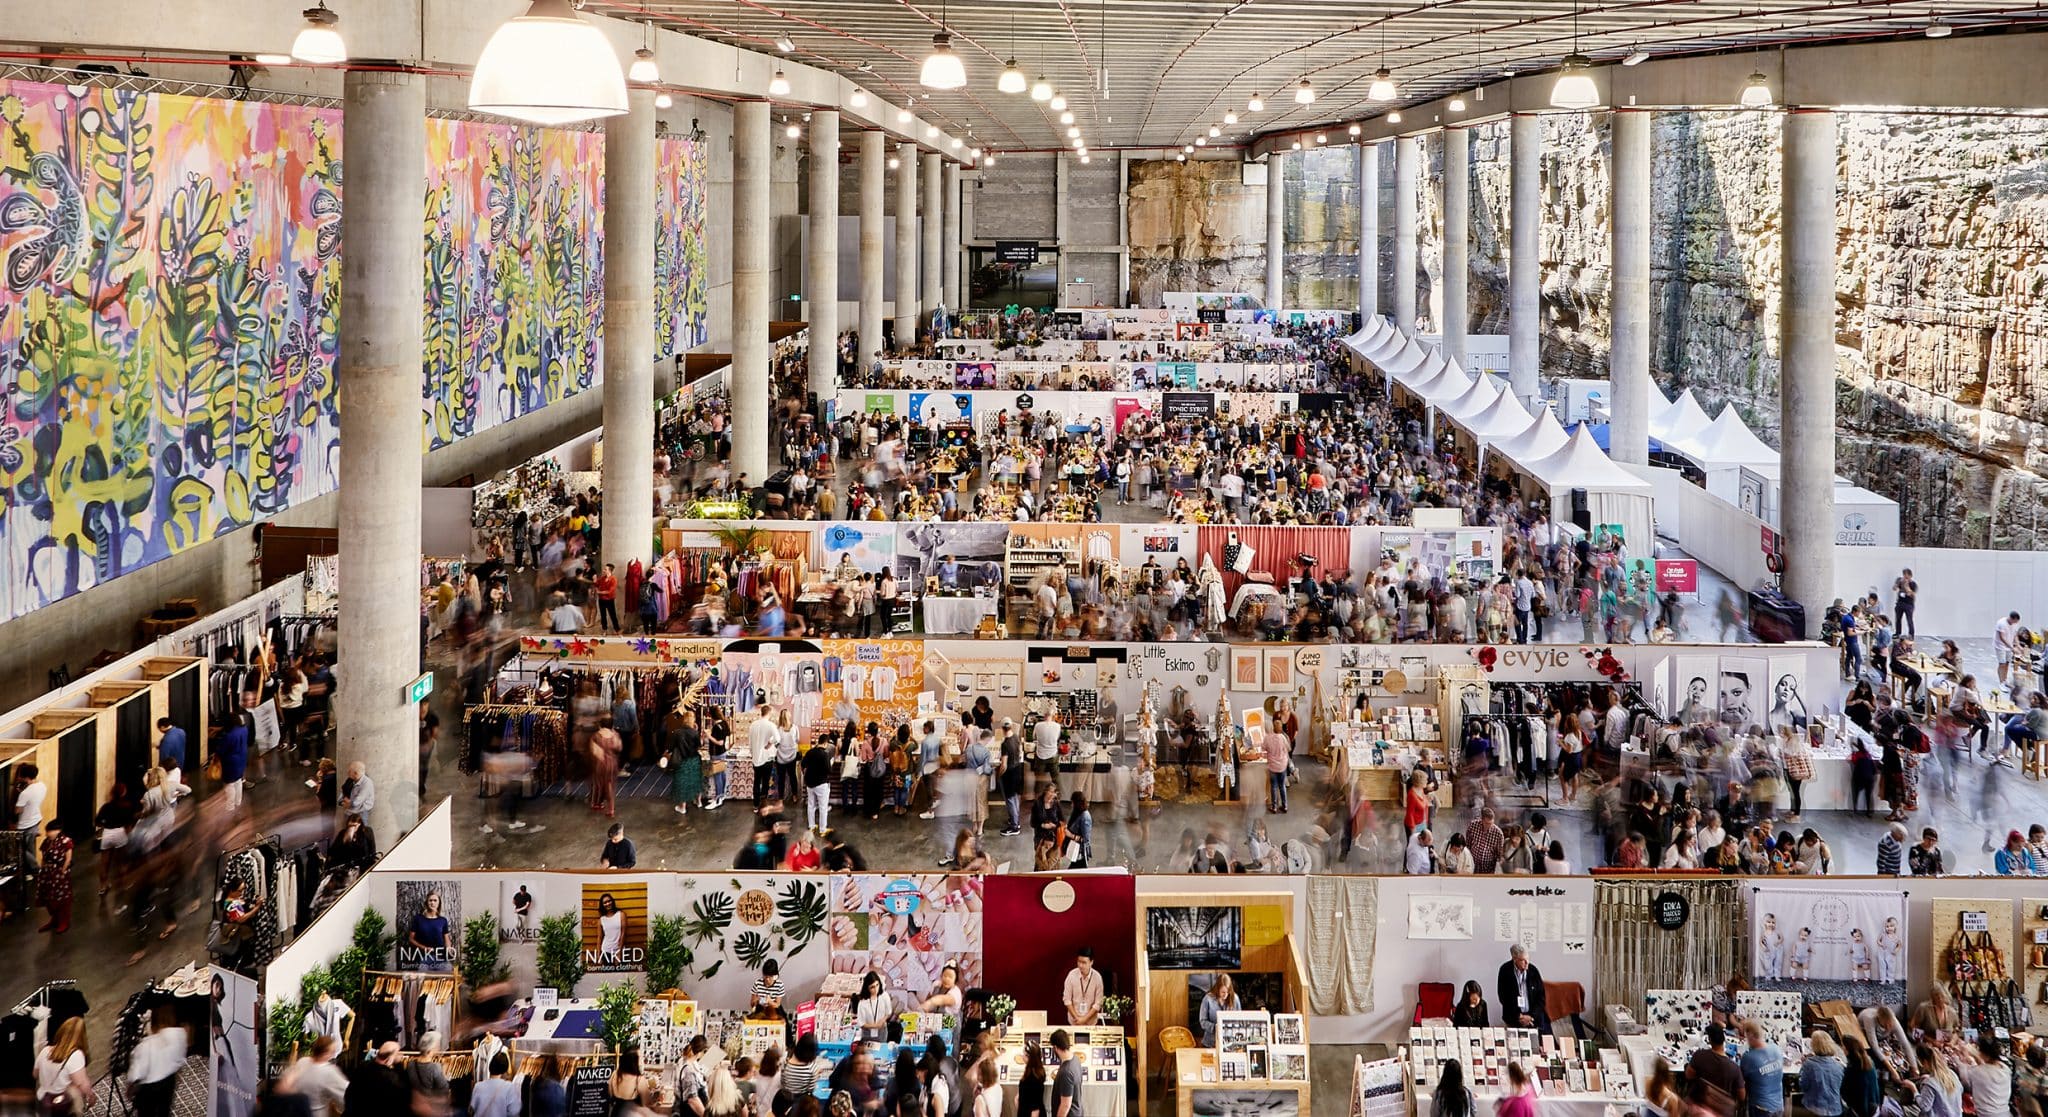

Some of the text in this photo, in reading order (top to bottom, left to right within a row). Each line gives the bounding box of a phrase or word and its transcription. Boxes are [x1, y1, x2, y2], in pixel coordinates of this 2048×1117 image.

[1836, 531, 1875, 542] CHILL
[1143, 646, 1166, 658] Little
[1165, 659, 1195, 671] Eskimo
[1503, 648, 1570, 673] evyie
[501, 927, 541, 938] NAKED
[400, 946, 457, 961] NAKED
[585, 947, 644, 963] NAKED
[587, 963, 643, 972] bamboo clothing
[577, 1067, 612, 1080] NAKED
